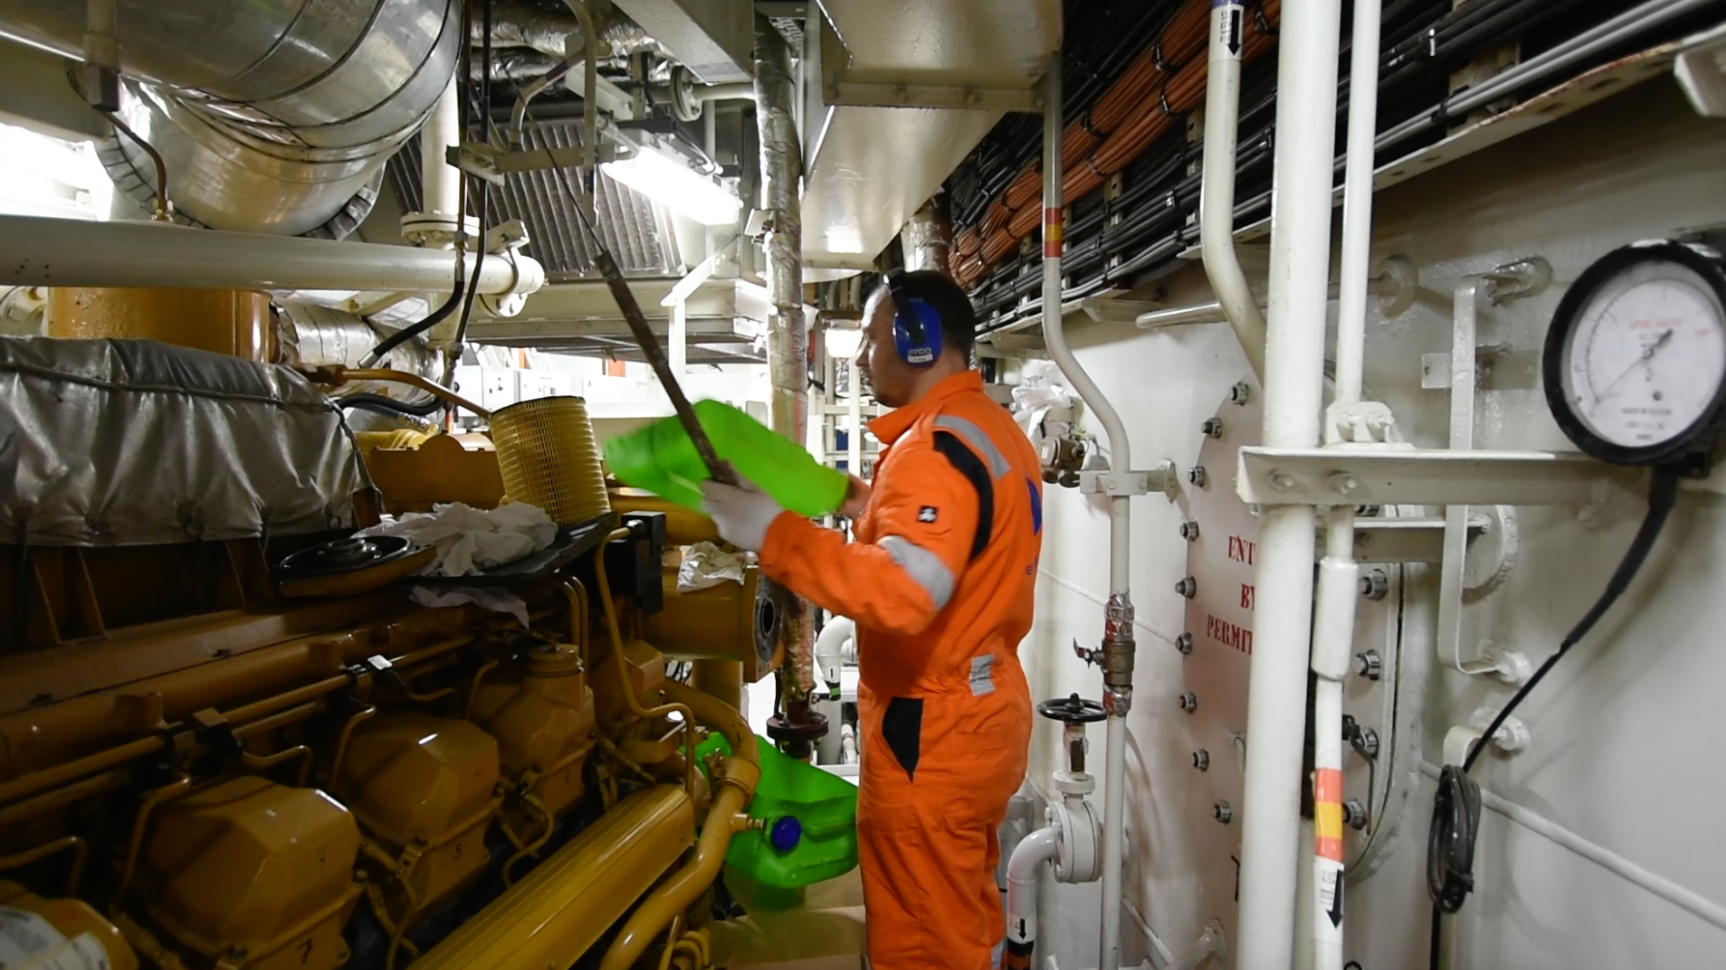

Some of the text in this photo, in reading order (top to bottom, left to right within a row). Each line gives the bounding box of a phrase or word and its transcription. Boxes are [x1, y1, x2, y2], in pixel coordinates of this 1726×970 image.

[1228, 535, 1257, 567] ENT
[452, 843, 462, 861] 5
[295, 937, 313, 965] 7
